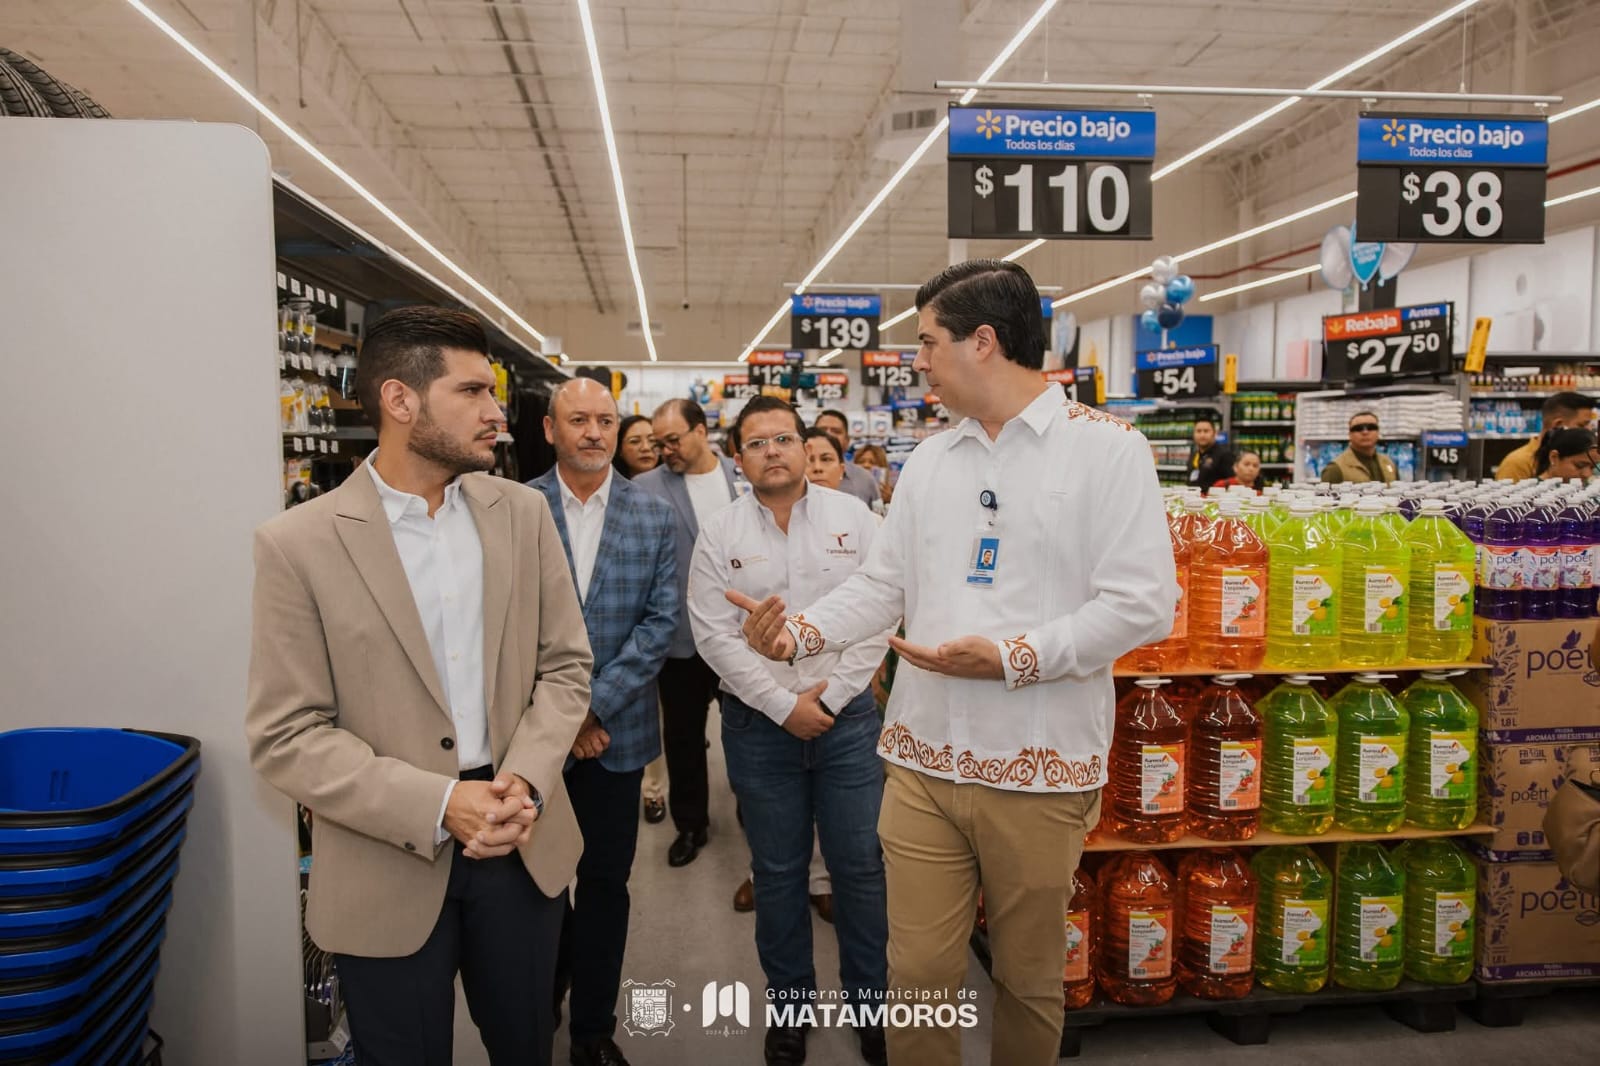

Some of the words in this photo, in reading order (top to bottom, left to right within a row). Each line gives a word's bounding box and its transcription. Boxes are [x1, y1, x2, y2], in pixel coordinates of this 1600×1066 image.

[1005, 115, 1077, 136] Precio
[1081, 115, 1131, 142] bajo
[1409, 123, 1475, 145] Precio
[1479, 124, 1524, 149] bajo
[1005, 139, 1036, 150] Todos
[1037, 140, 1053, 150] los
[1408, 146, 1438, 157] Todos
[1439, 147, 1453, 157] los
[974, 164, 1130, 233] $110
[1402, 170, 1503, 237] $38
[801, 317, 870, 348] $139
[1345, 315, 1398, 332] Rebaja
[1408, 307, 1440, 319] Antes
[1154, 367, 1197, 395] $54
[1433, 448, 1458, 463] $45
[1527, 644, 1592, 679] poet
[1525, 734, 1556, 742] AROMAS
[1511, 788, 1549, 804] poett
